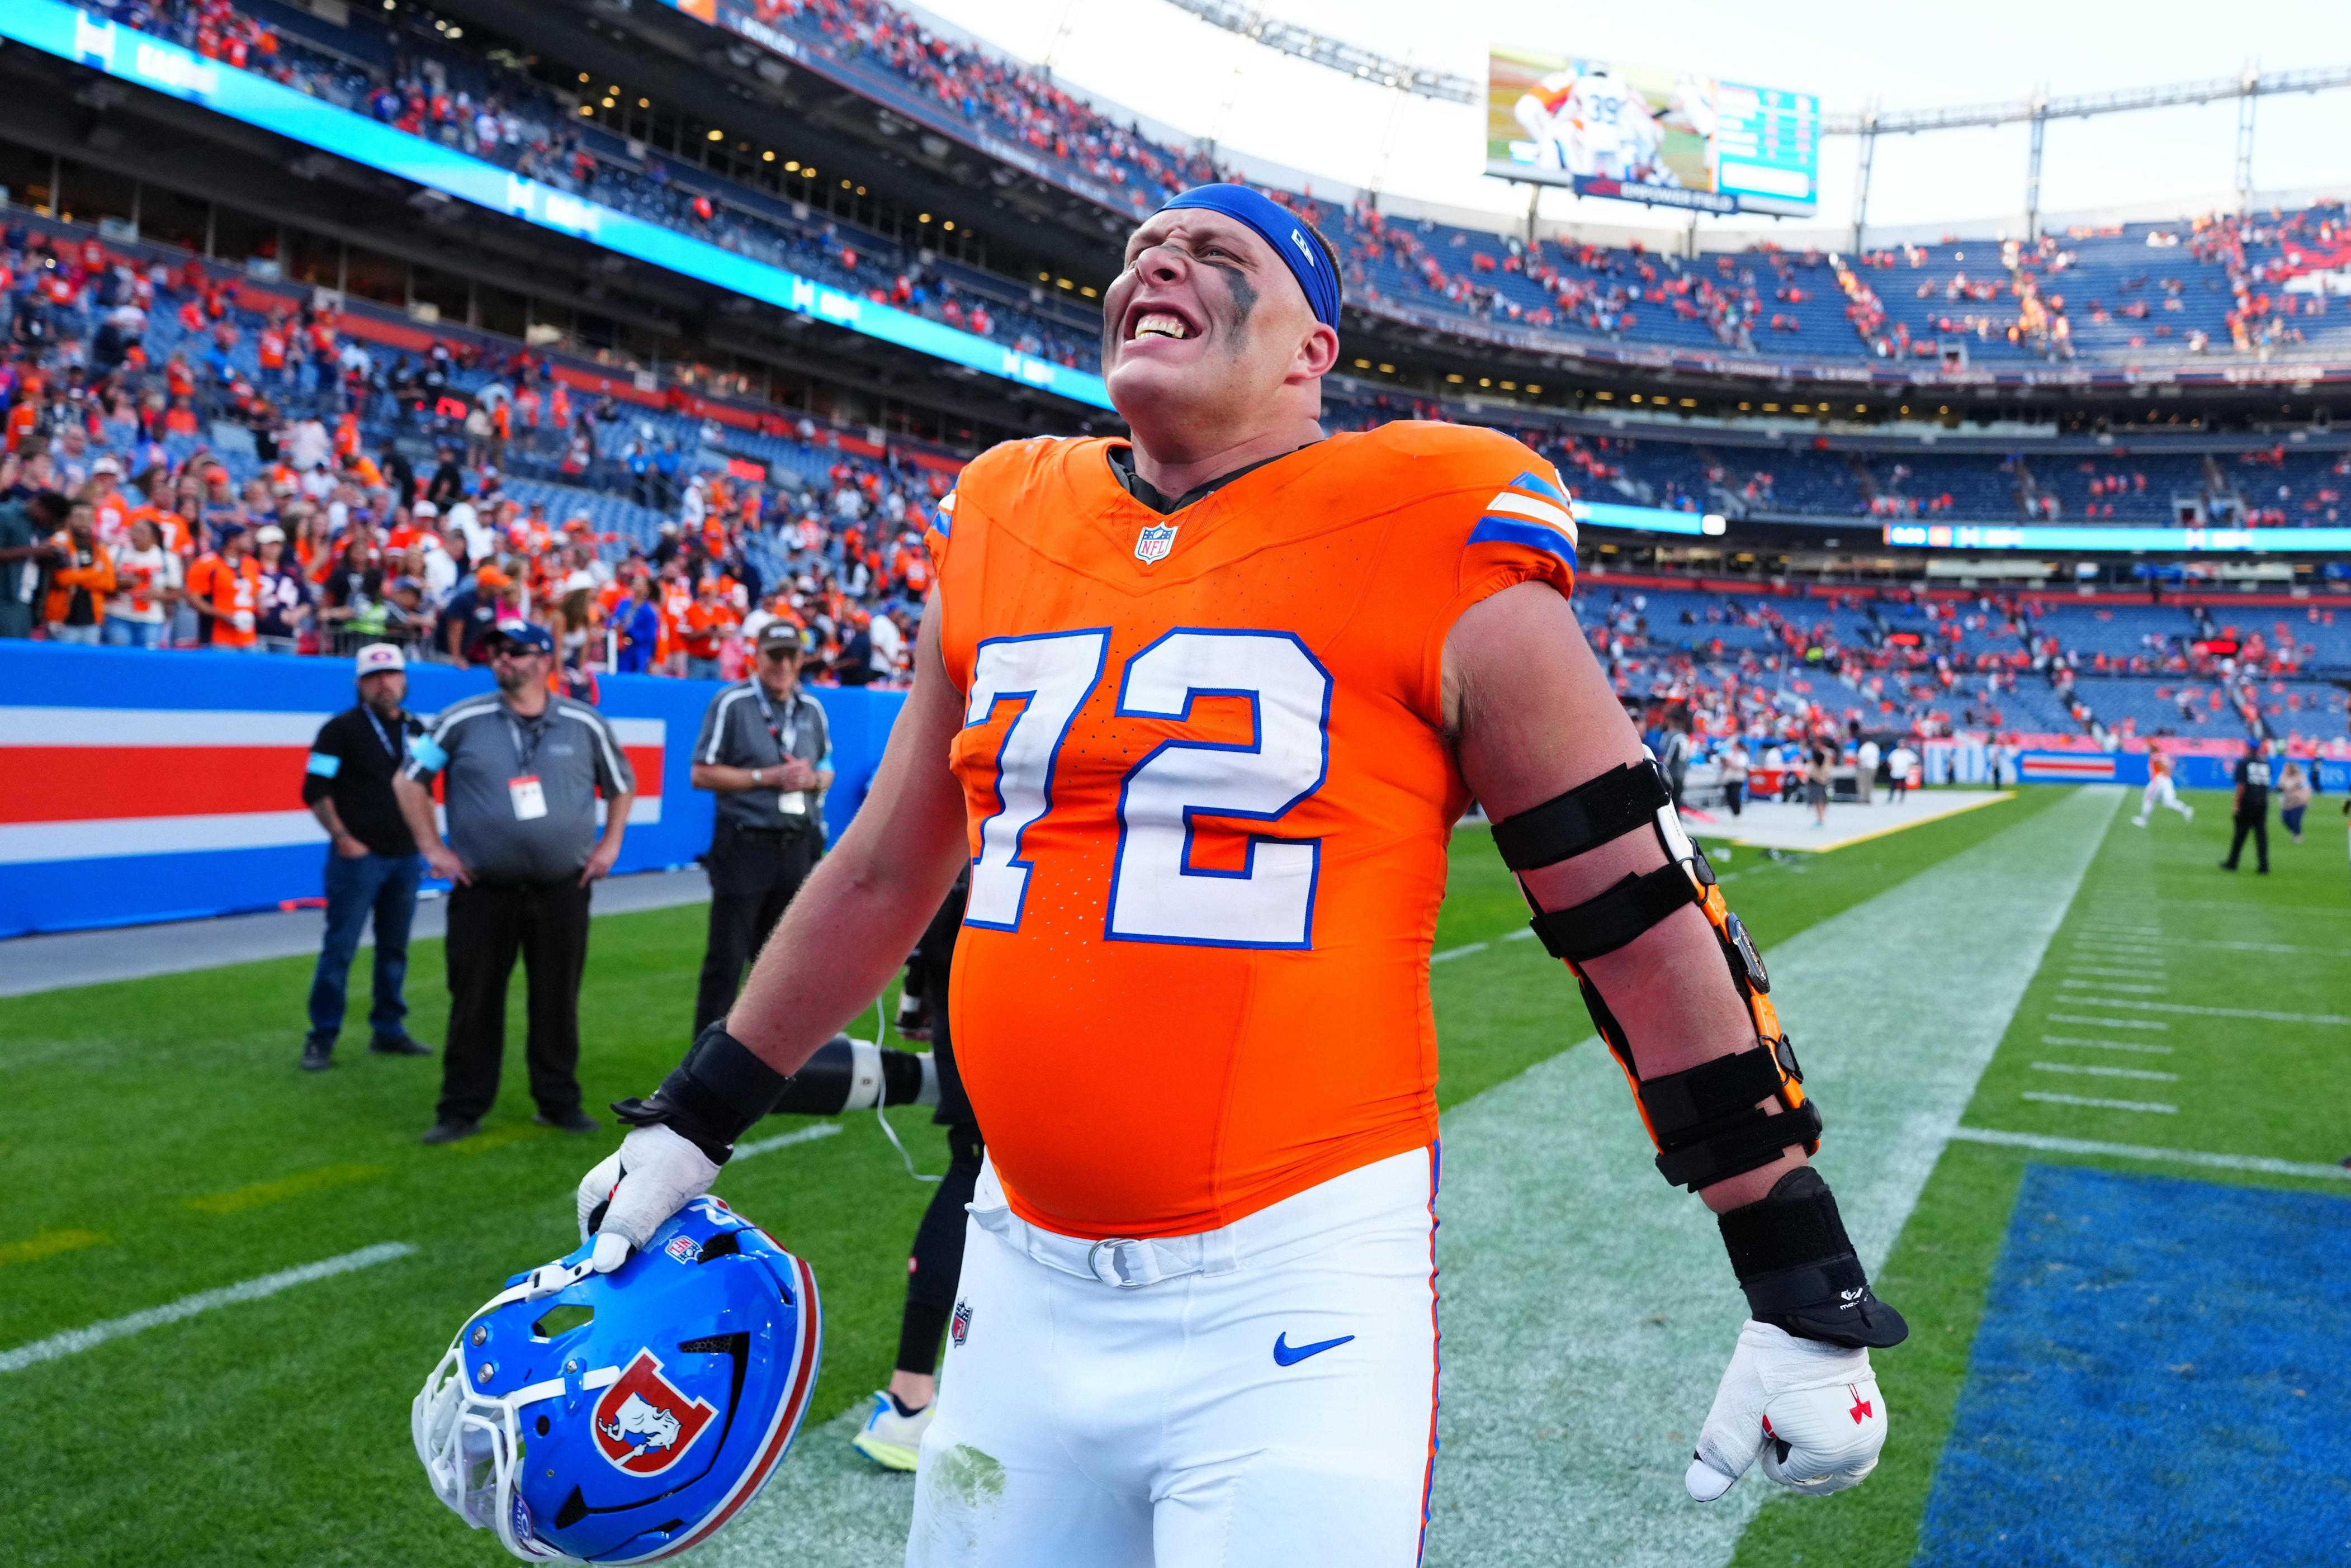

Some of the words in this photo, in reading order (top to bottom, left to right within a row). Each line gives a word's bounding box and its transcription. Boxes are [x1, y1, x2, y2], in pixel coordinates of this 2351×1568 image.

[1621, 182, 1692, 207] EMPOWER
[1693, 191, 1734, 212] FIELD
[1141, 540, 1165, 556] NFL
[963, 626, 1335, 950] 72
[1738, 926, 1767, 980] DONJOY
[669, 1237, 693, 1254] NFL
